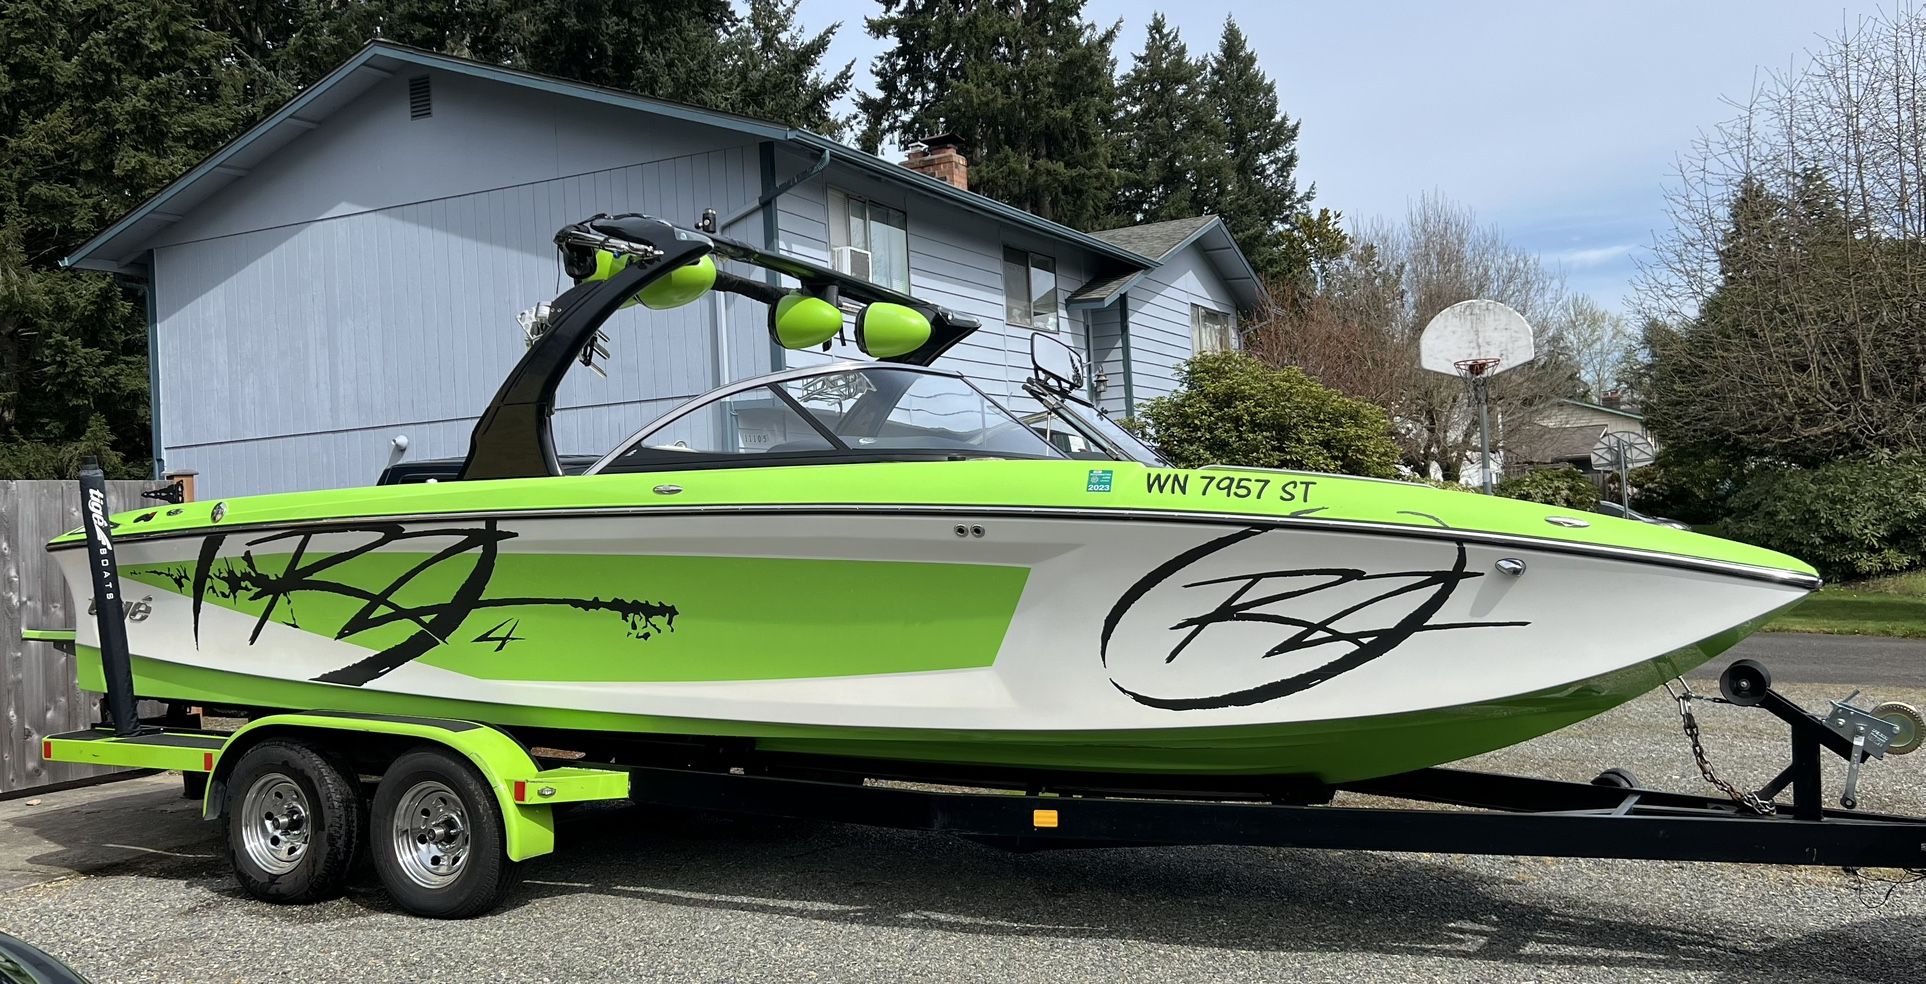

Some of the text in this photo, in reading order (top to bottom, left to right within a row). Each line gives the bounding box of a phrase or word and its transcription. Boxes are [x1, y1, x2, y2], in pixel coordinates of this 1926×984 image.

[1086, 480, 1110, 491] 2023
[1146, 472, 1318, 503] WN 7957 ST
[99, 547, 114, 600] BOATS
[470, 617, 526, 652] 4
